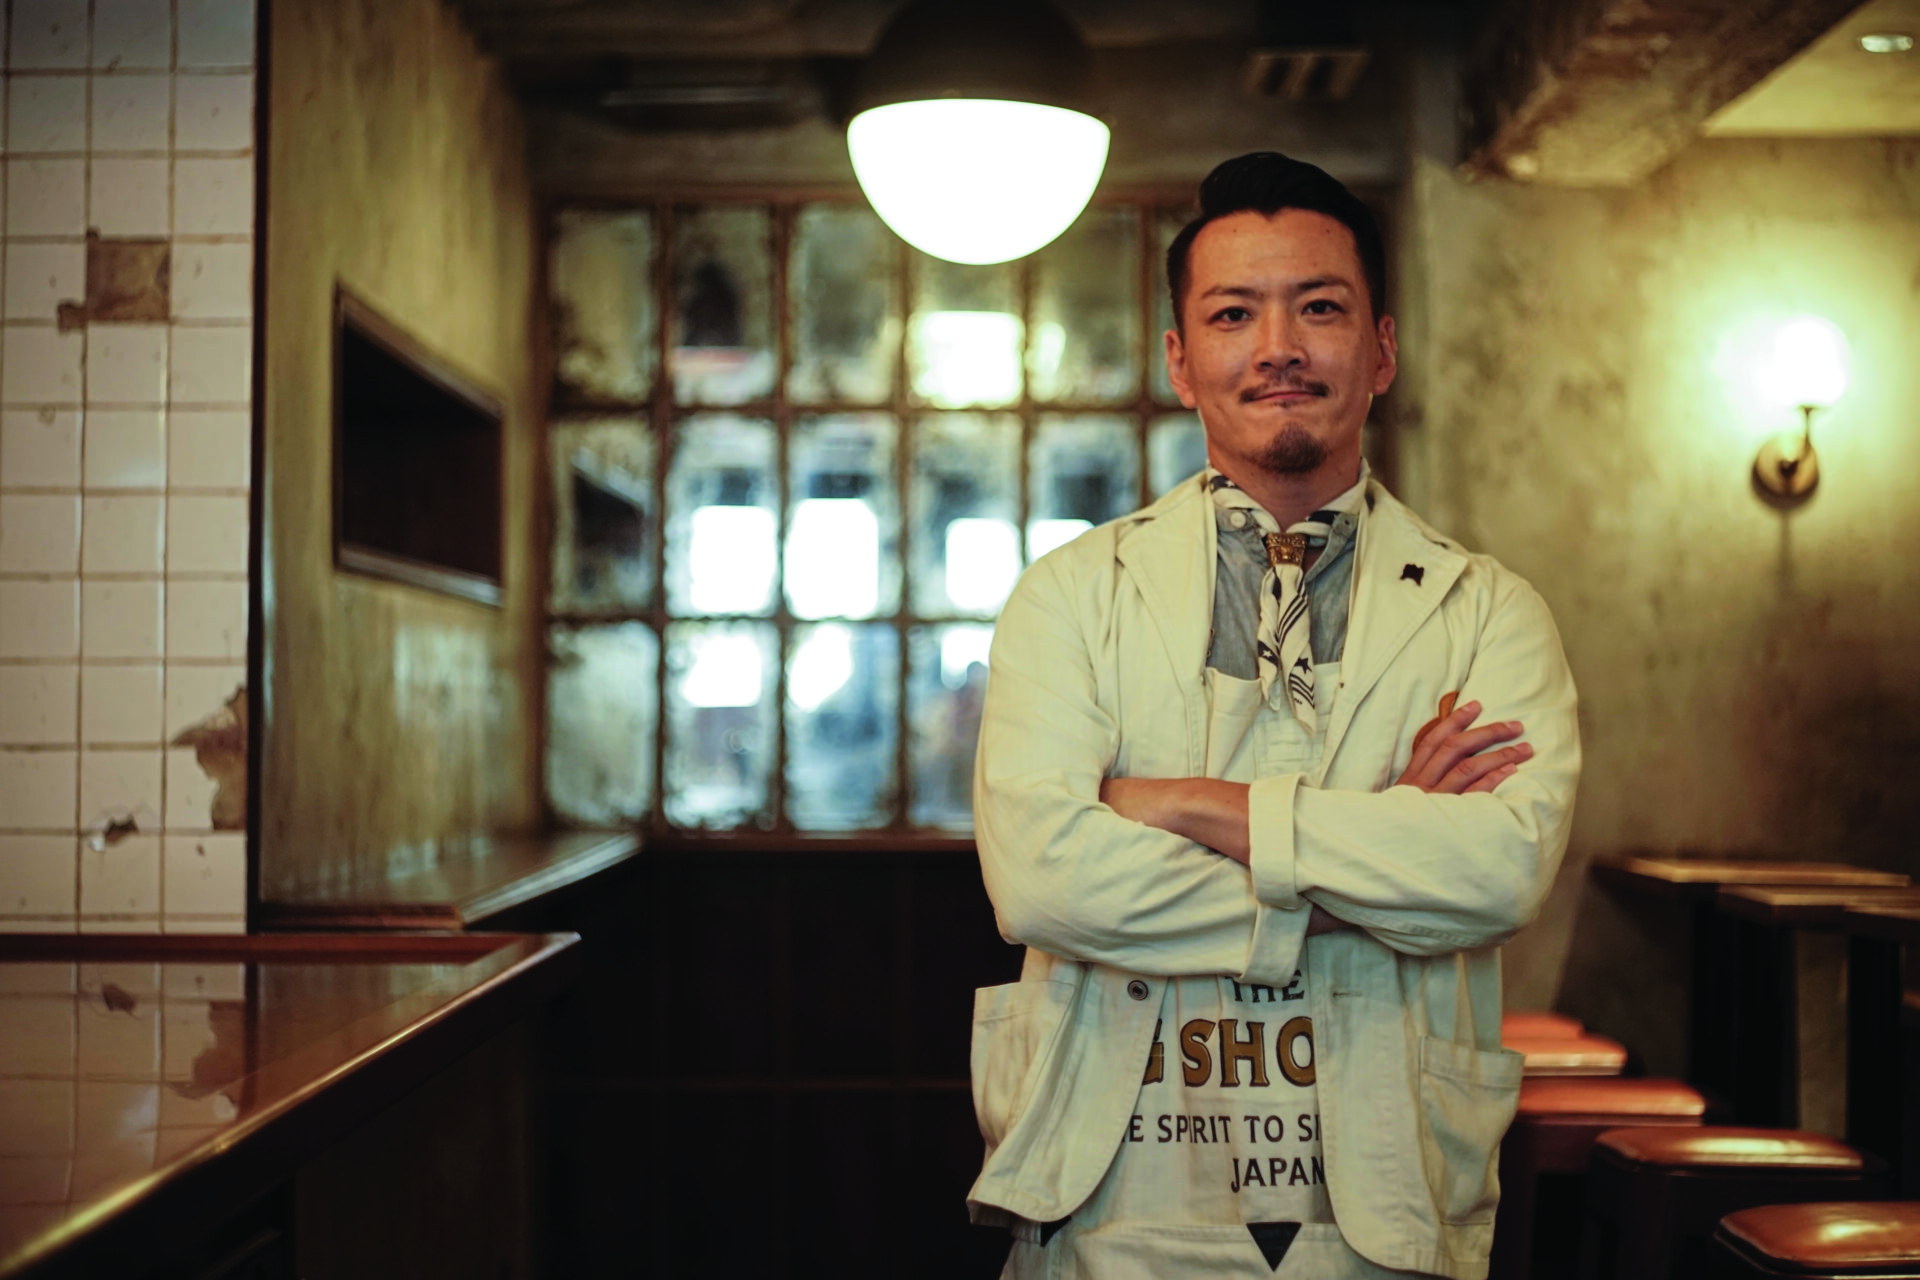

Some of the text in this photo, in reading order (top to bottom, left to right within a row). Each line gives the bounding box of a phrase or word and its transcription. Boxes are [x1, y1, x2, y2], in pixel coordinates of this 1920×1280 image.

[1157, 1114, 1231, 1143] SPIRIT
[1243, 1115, 1284, 1143] TO
[1231, 1156, 1324, 1193] JAPAN
